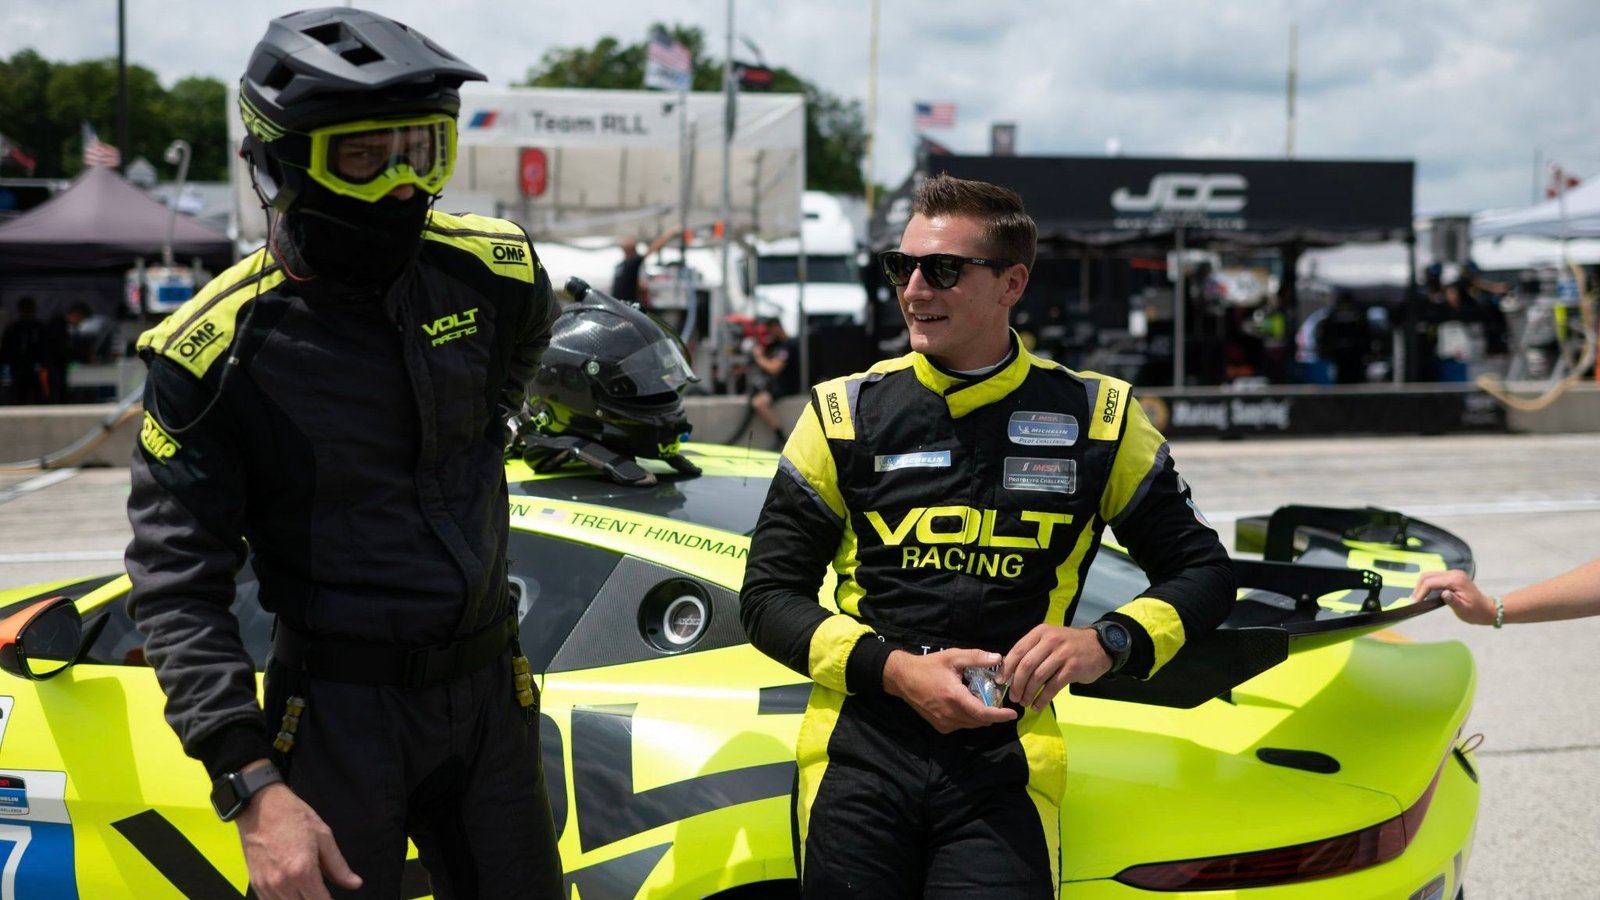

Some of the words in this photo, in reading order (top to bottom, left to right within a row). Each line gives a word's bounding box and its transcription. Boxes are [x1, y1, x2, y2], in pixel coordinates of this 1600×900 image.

[531, 110, 595, 132] Team
[601, 113, 647, 134] RLL
[1110, 172, 1248, 213] JDC
[492, 245, 526, 262] OMP
[421, 307, 478, 337] VOLT
[431, 326, 478, 347] RACING
[179, 322, 215, 358] OMP
[826, 392, 843, 424] sparco
[1102, 388, 1118, 424] sparco
[142, 416, 177, 458] OMP
[570, 512, 642, 535] TRENT
[864, 505, 1074, 550] VOLT
[901, 546, 1025, 578] RACING
